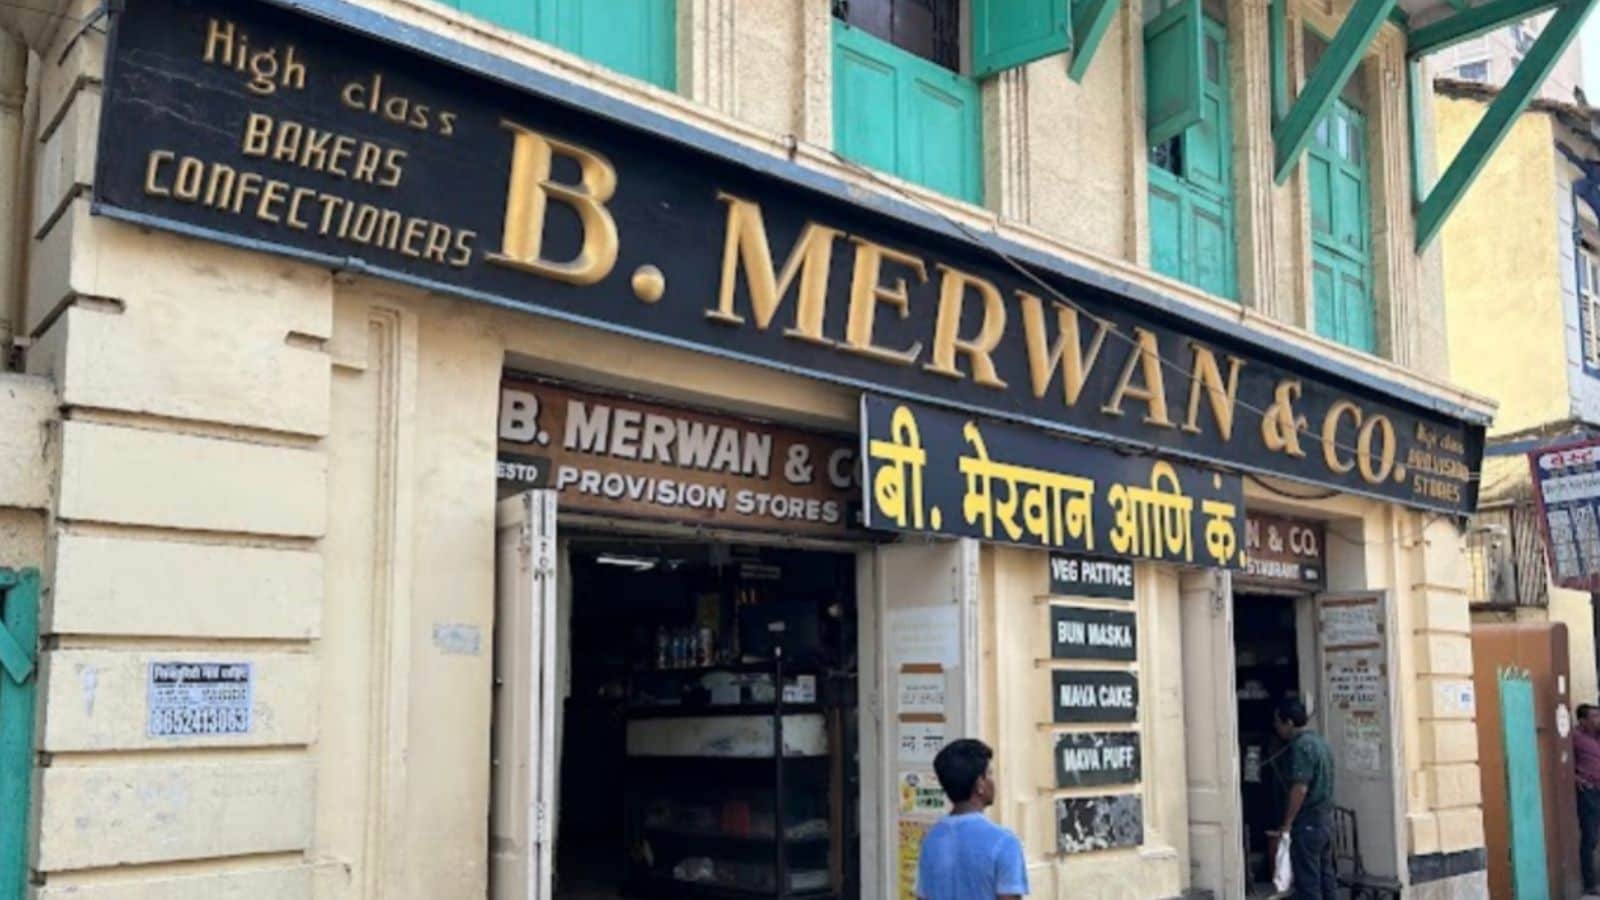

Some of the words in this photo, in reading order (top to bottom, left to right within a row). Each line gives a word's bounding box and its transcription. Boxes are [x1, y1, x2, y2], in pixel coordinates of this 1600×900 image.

[203, 18, 307, 95] High
[342, 75, 457, 136] class
[242, 113, 408, 187] BAKERS
[145, 149, 477, 267] CONFECTIONERS
[484, 119, 667, 303] B.
[704, 191, 1248, 442] MERWAN
[1261, 380, 1308, 458] &
[1321, 399, 1407, 485] CO.
[500, 388, 550, 445] B.
[563, 400, 772, 479] MERWAN
[784, 444, 812, 487] &
[557, 465, 726, 510] PROVISION
[736, 492, 839, 524] STORES
[870, 405, 942, 531] बी.
[959, 420, 1096, 552] मेरवान
[1108, 460, 1194, 563] आणि
[1051, 557, 1079, 582] VEG
[1081, 561, 1132, 587] PATTICE
[1058, 621, 1085, 645] BUN
[1088, 623, 1133, 648] MASKA
[1099, 685, 1134, 708] CAKE
[1102, 746, 1135, 771] PUFF
